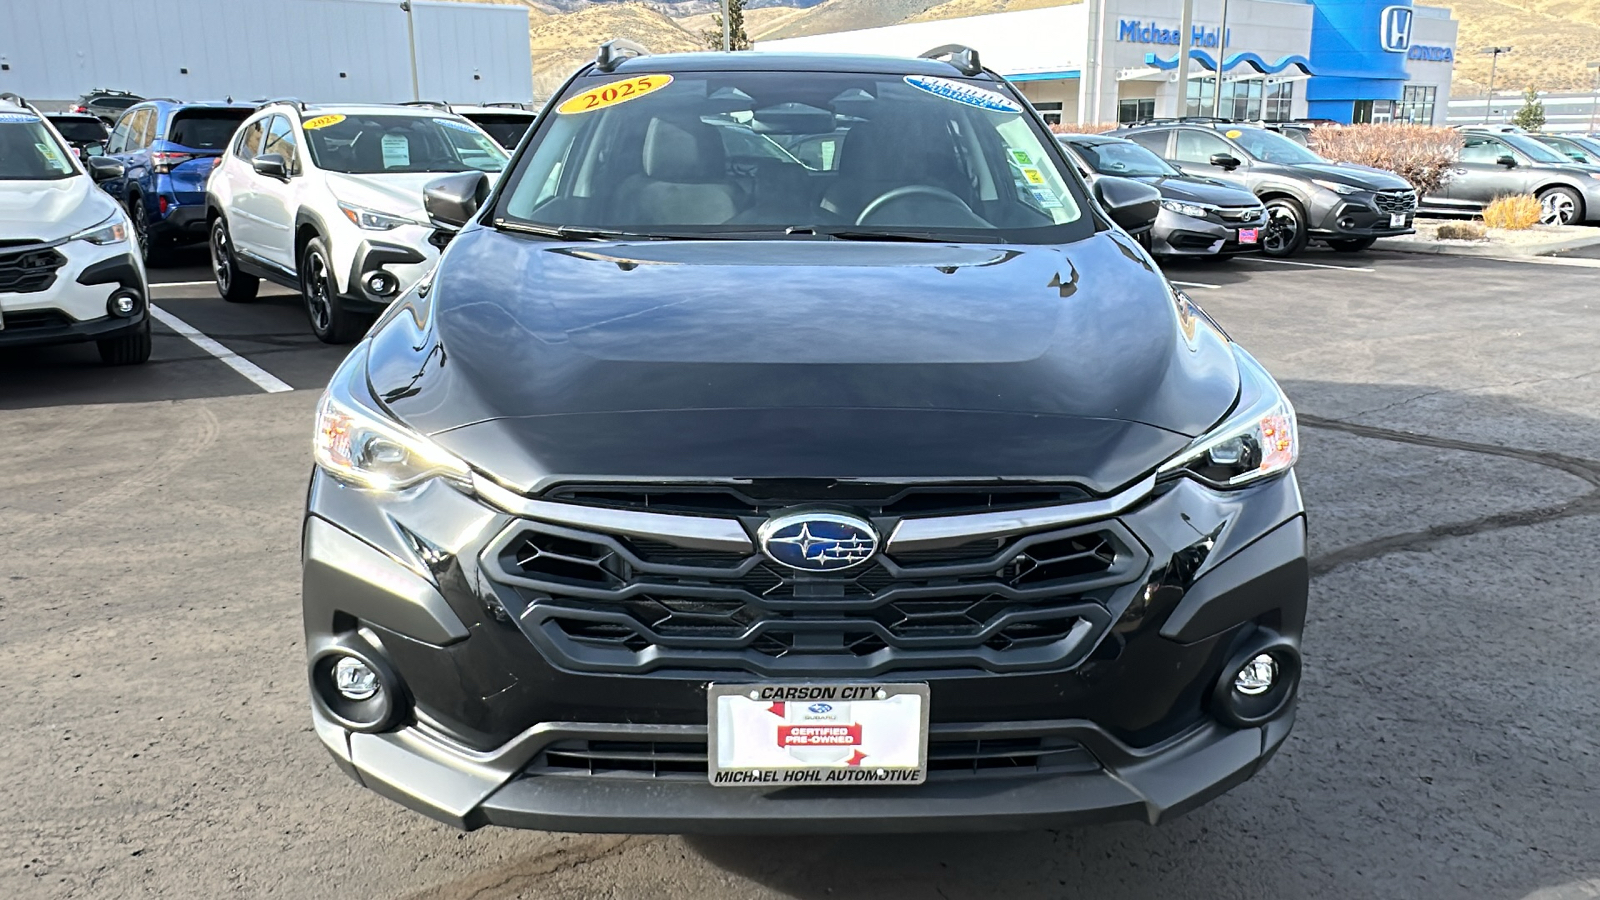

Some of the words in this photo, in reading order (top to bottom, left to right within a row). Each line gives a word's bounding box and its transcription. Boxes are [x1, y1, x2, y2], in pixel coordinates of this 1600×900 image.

[1119, 19, 1181, 46] Michae
[1408, 44, 1453, 62] ONDA
[582, 77, 652, 109] 2025
[761, 686, 837, 699] CARSON
[841, 686, 881, 699] CITY
[791, 727, 848, 736] CERTIFIED
[785, 735, 854, 744] PRE-OWNED
[783, 769, 822, 782] HOHL
